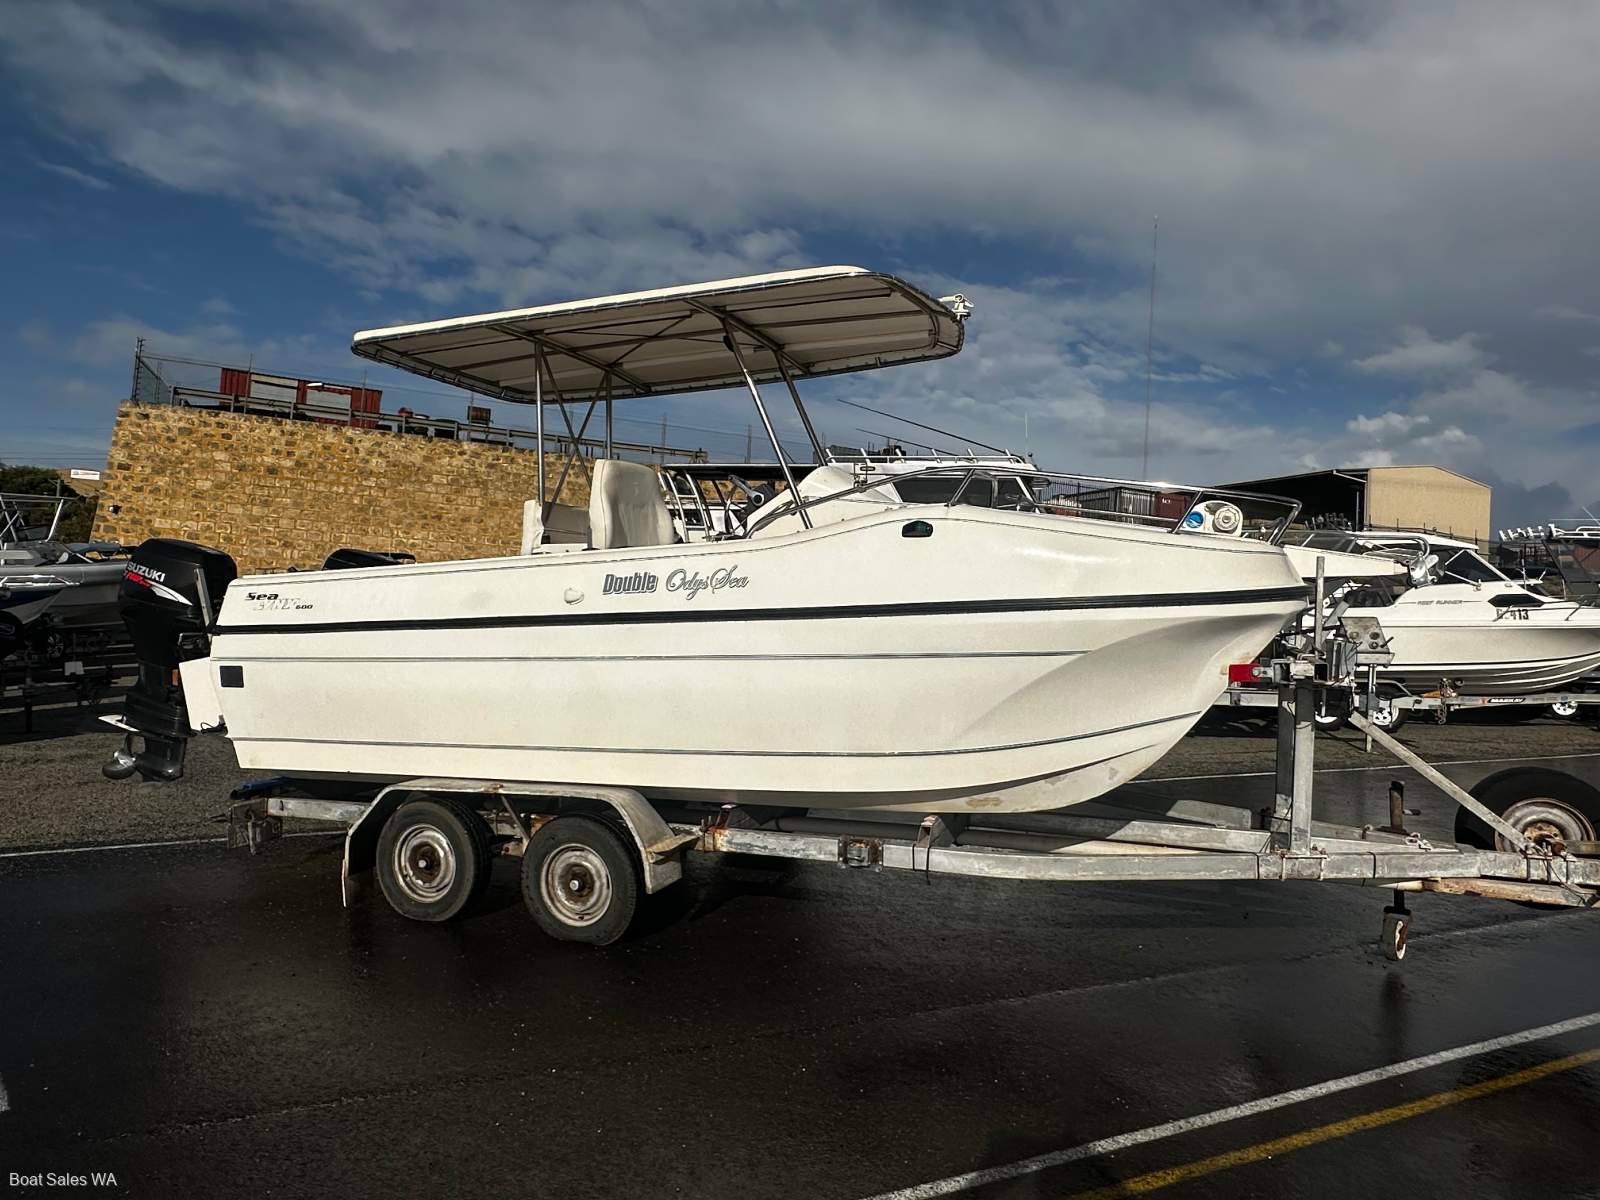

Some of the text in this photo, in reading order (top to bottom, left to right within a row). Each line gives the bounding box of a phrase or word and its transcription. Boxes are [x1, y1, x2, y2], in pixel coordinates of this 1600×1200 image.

[127, 561, 166, 583] SUZUKI
[602, 571, 658, 595] Double
[245, 592, 279, 600] Sea
